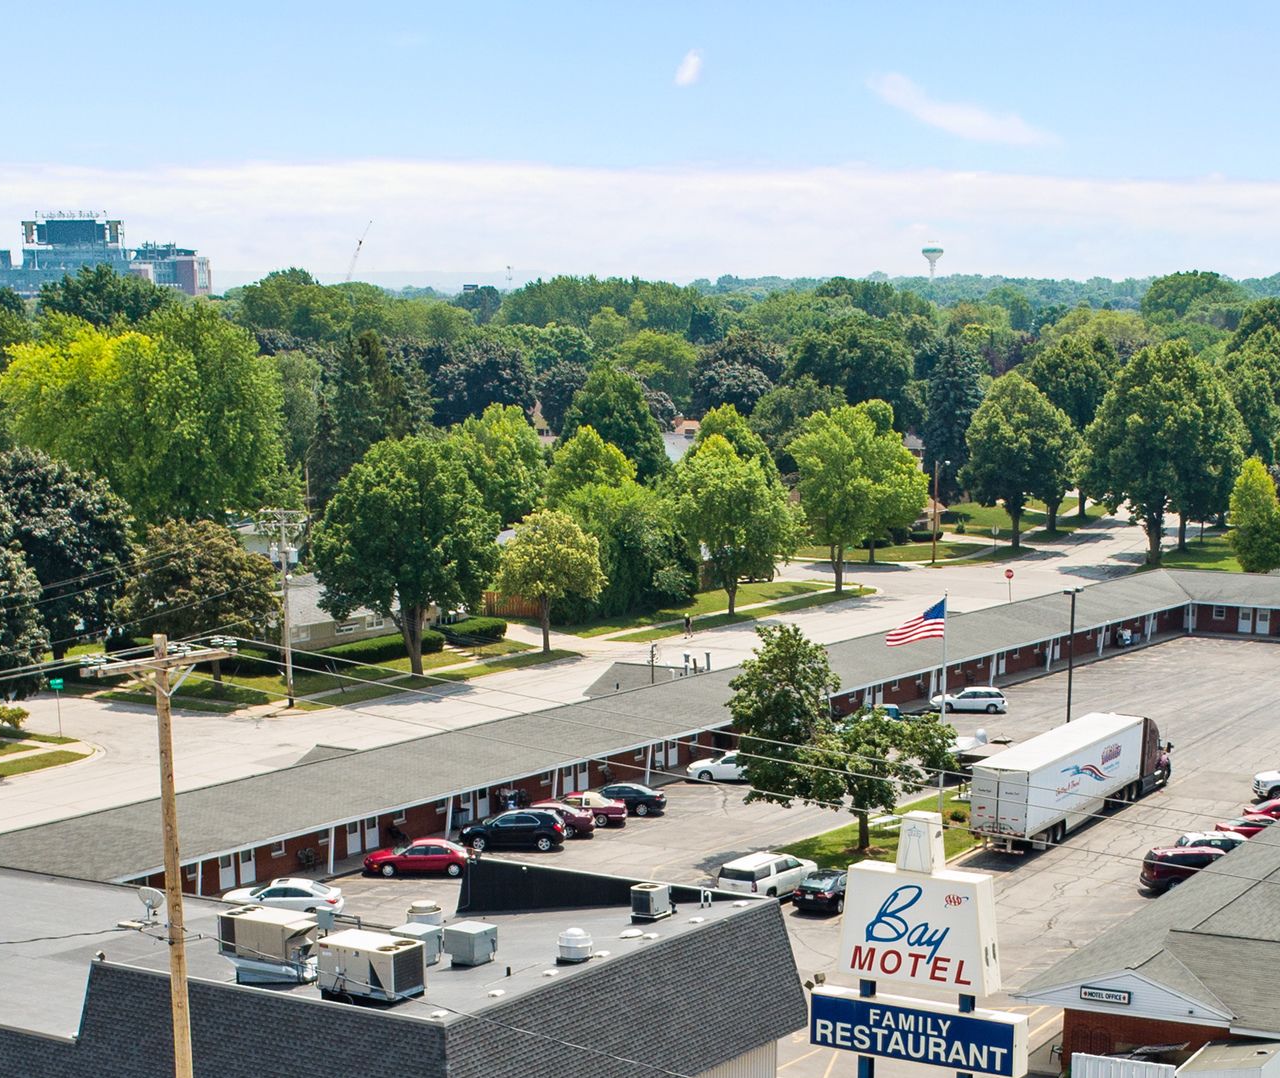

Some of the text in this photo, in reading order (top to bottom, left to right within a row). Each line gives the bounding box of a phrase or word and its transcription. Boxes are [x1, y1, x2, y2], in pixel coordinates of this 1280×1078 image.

[865, 884, 951, 965] Bay
[850, 945, 972, 986] MOTEL
[1105, 993, 1122, 1001] OFFICE
[869, 1008, 952, 1037] FAMILY
[815, 1018, 1008, 1072] RESTAURANT
